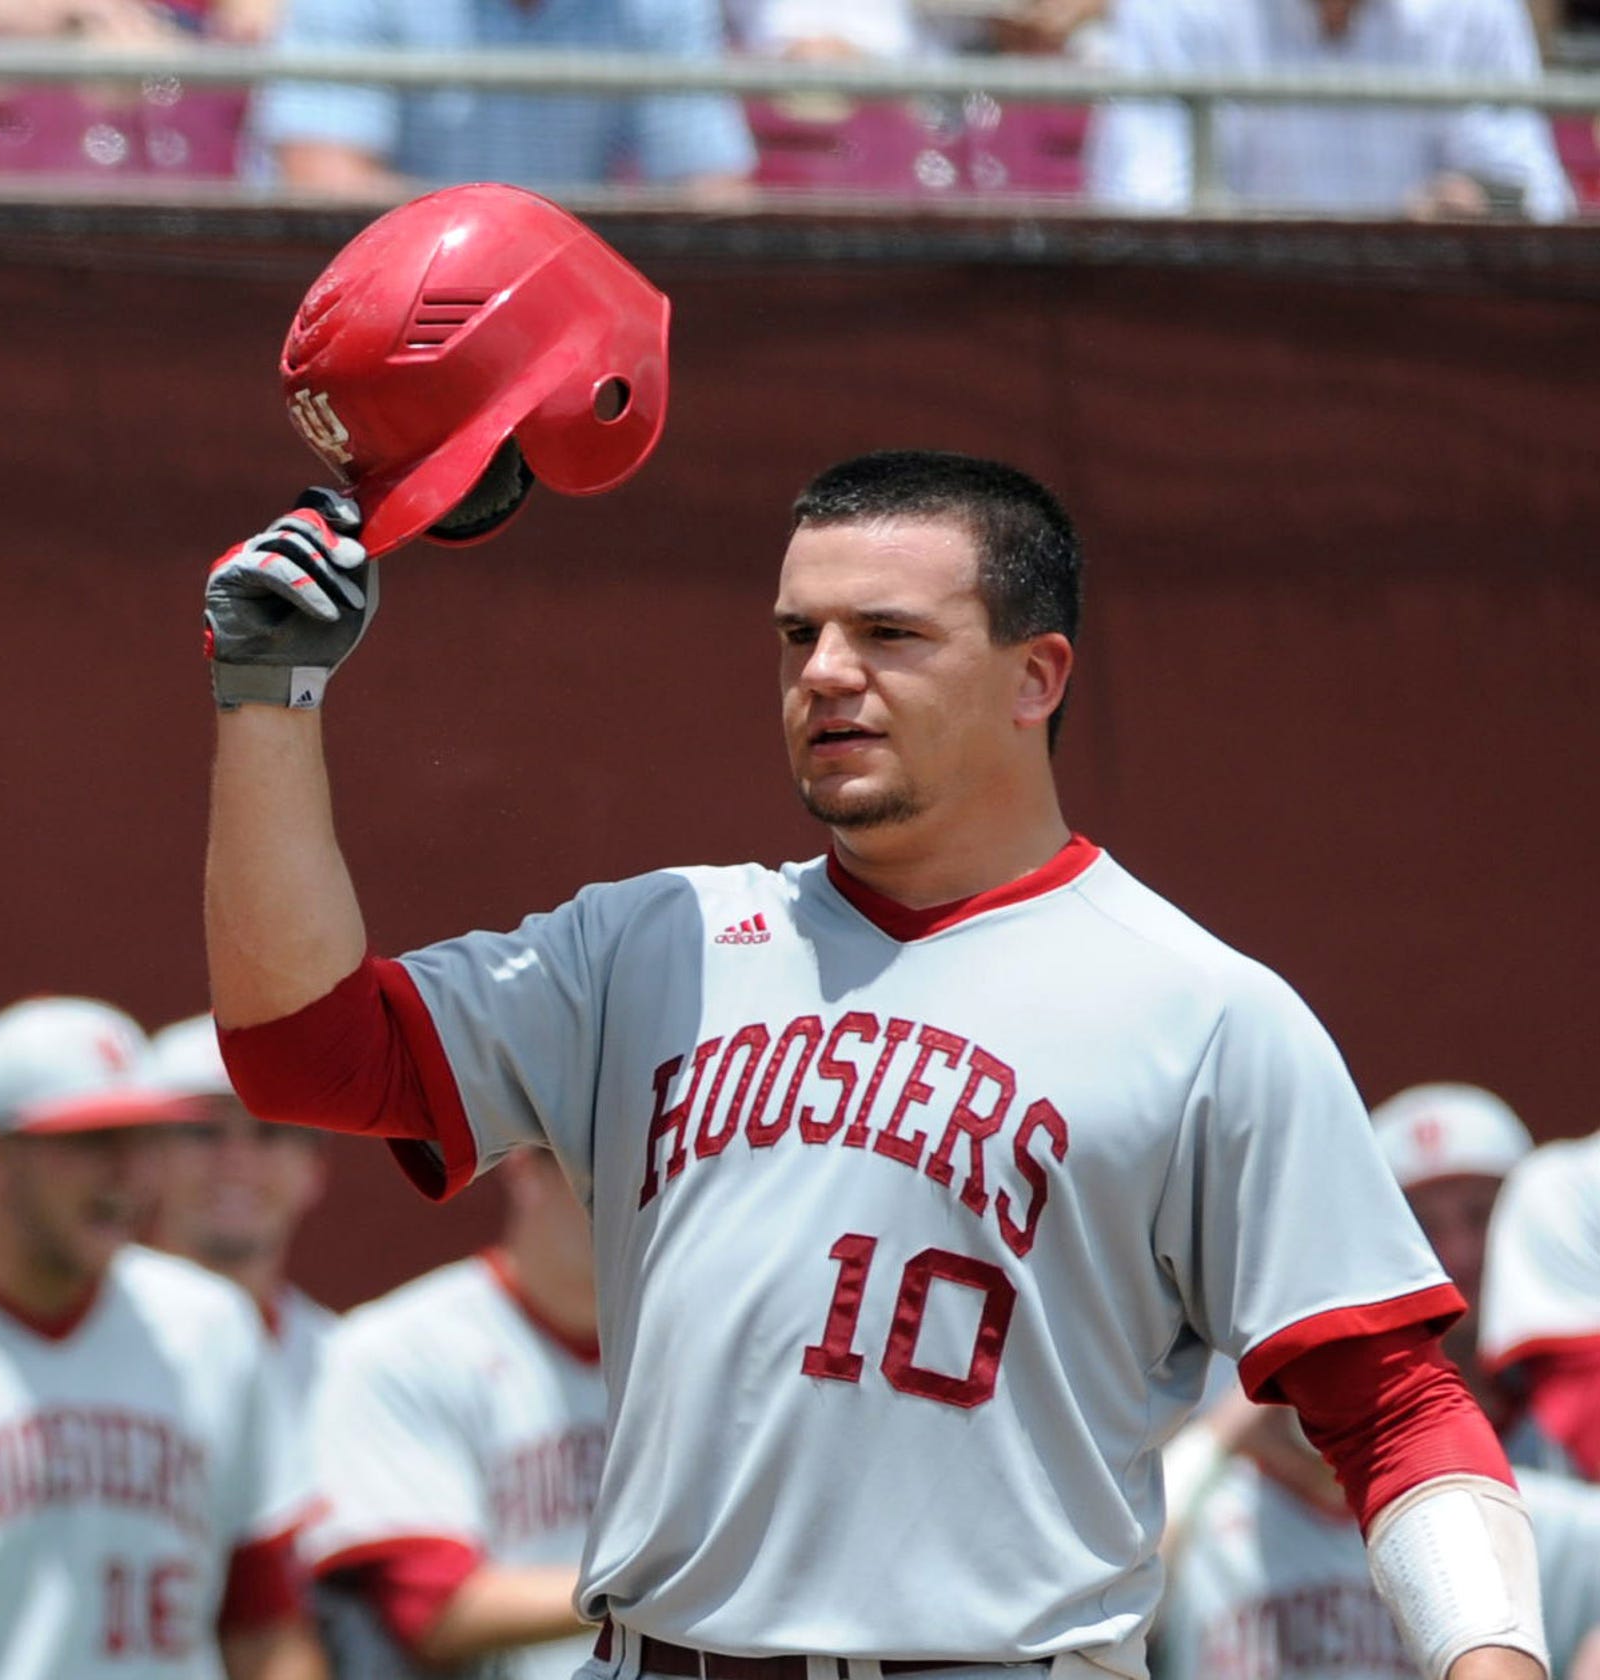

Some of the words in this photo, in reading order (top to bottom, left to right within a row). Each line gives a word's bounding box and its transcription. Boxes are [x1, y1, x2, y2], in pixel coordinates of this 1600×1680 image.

[714, 931, 772, 945] adidas
[639, 1012, 1068, 1258] HOOSIERS
[801, 1233, 1017, 1409] 10
